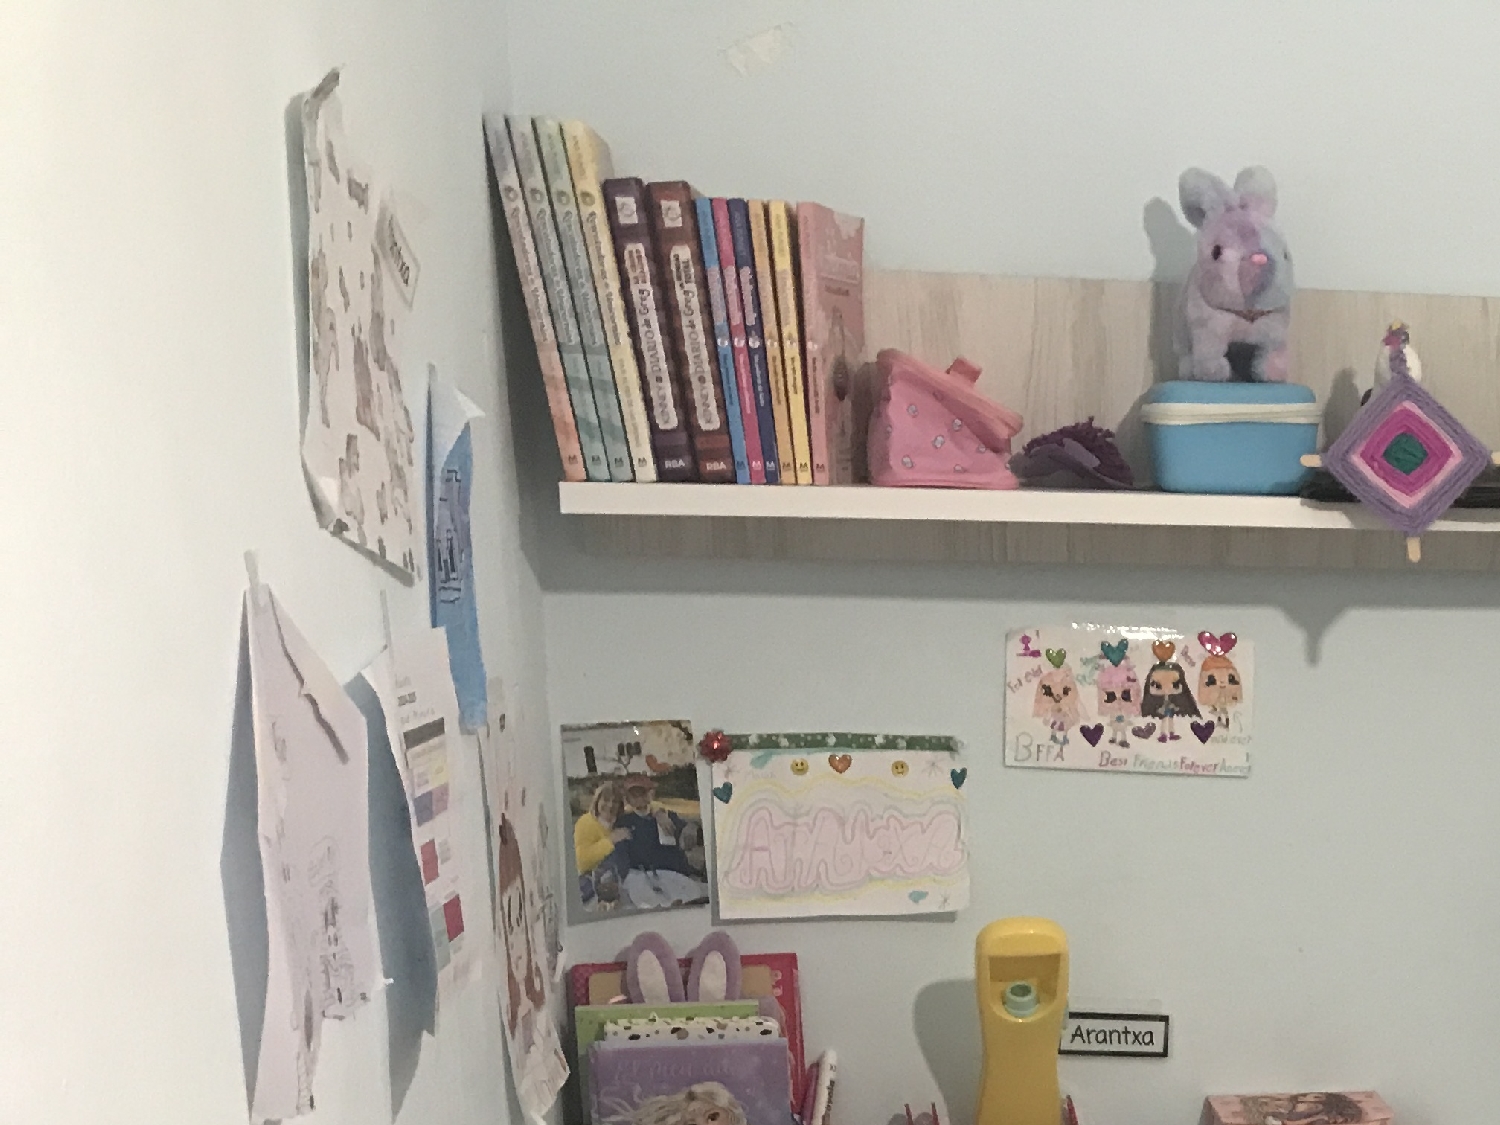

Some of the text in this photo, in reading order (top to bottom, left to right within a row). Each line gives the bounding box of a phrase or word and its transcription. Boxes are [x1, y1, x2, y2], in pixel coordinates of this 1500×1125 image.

[642, 328, 662, 373] DIARIO
[687, 330, 705, 375] DIARIO
[665, 459, 686, 468] RBA
[706, 461, 726, 470] RBA
[1070, 1024, 1155, 1046] Arantxa
